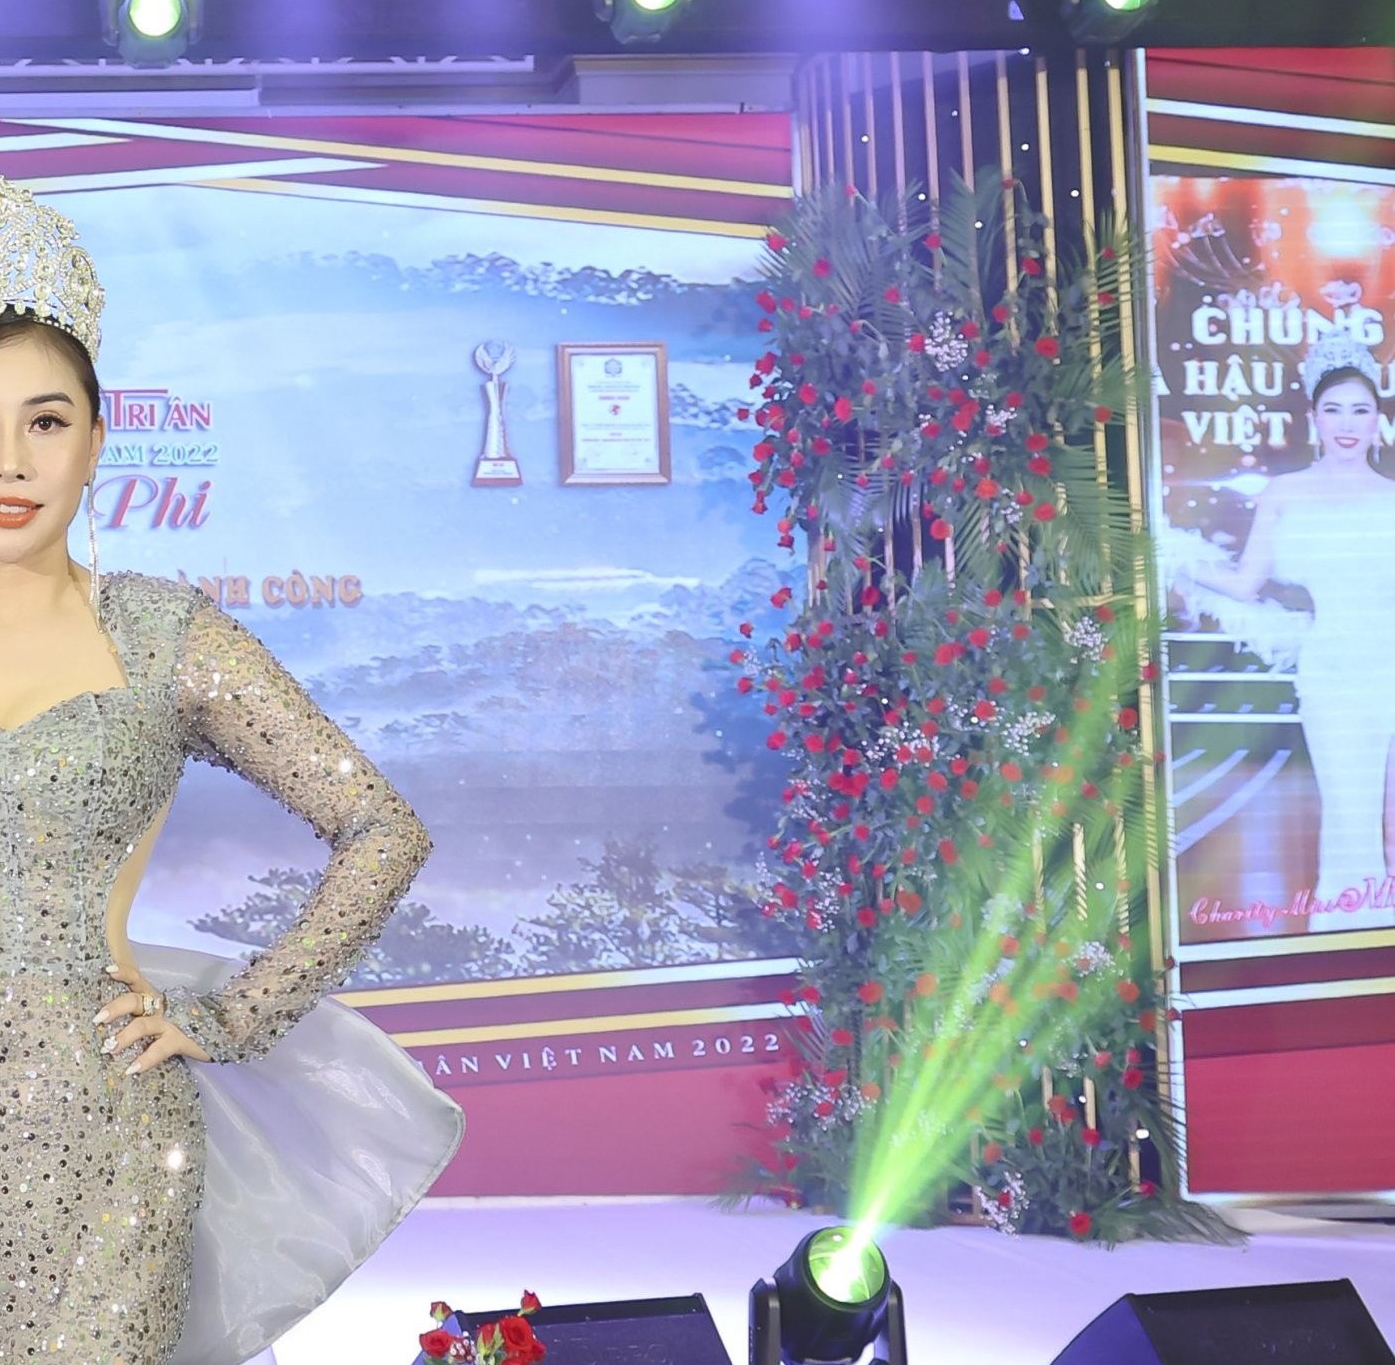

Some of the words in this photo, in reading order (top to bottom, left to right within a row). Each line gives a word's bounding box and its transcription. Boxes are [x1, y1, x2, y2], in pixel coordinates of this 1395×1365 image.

[1182, 353, 1285, 402] HẬU
[100, 388, 168, 431] TRI
[163, 395, 212, 431] ÂN
[1181, 404, 1294, 453] VIỆT
[98, 442, 144, 467] AM
[150, 441, 222, 467] 2022
[495, 1046, 583, 1071] VIỆT
[598, 1041, 676, 1064] NAM
[692, 1034, 780, 1057] 2022
